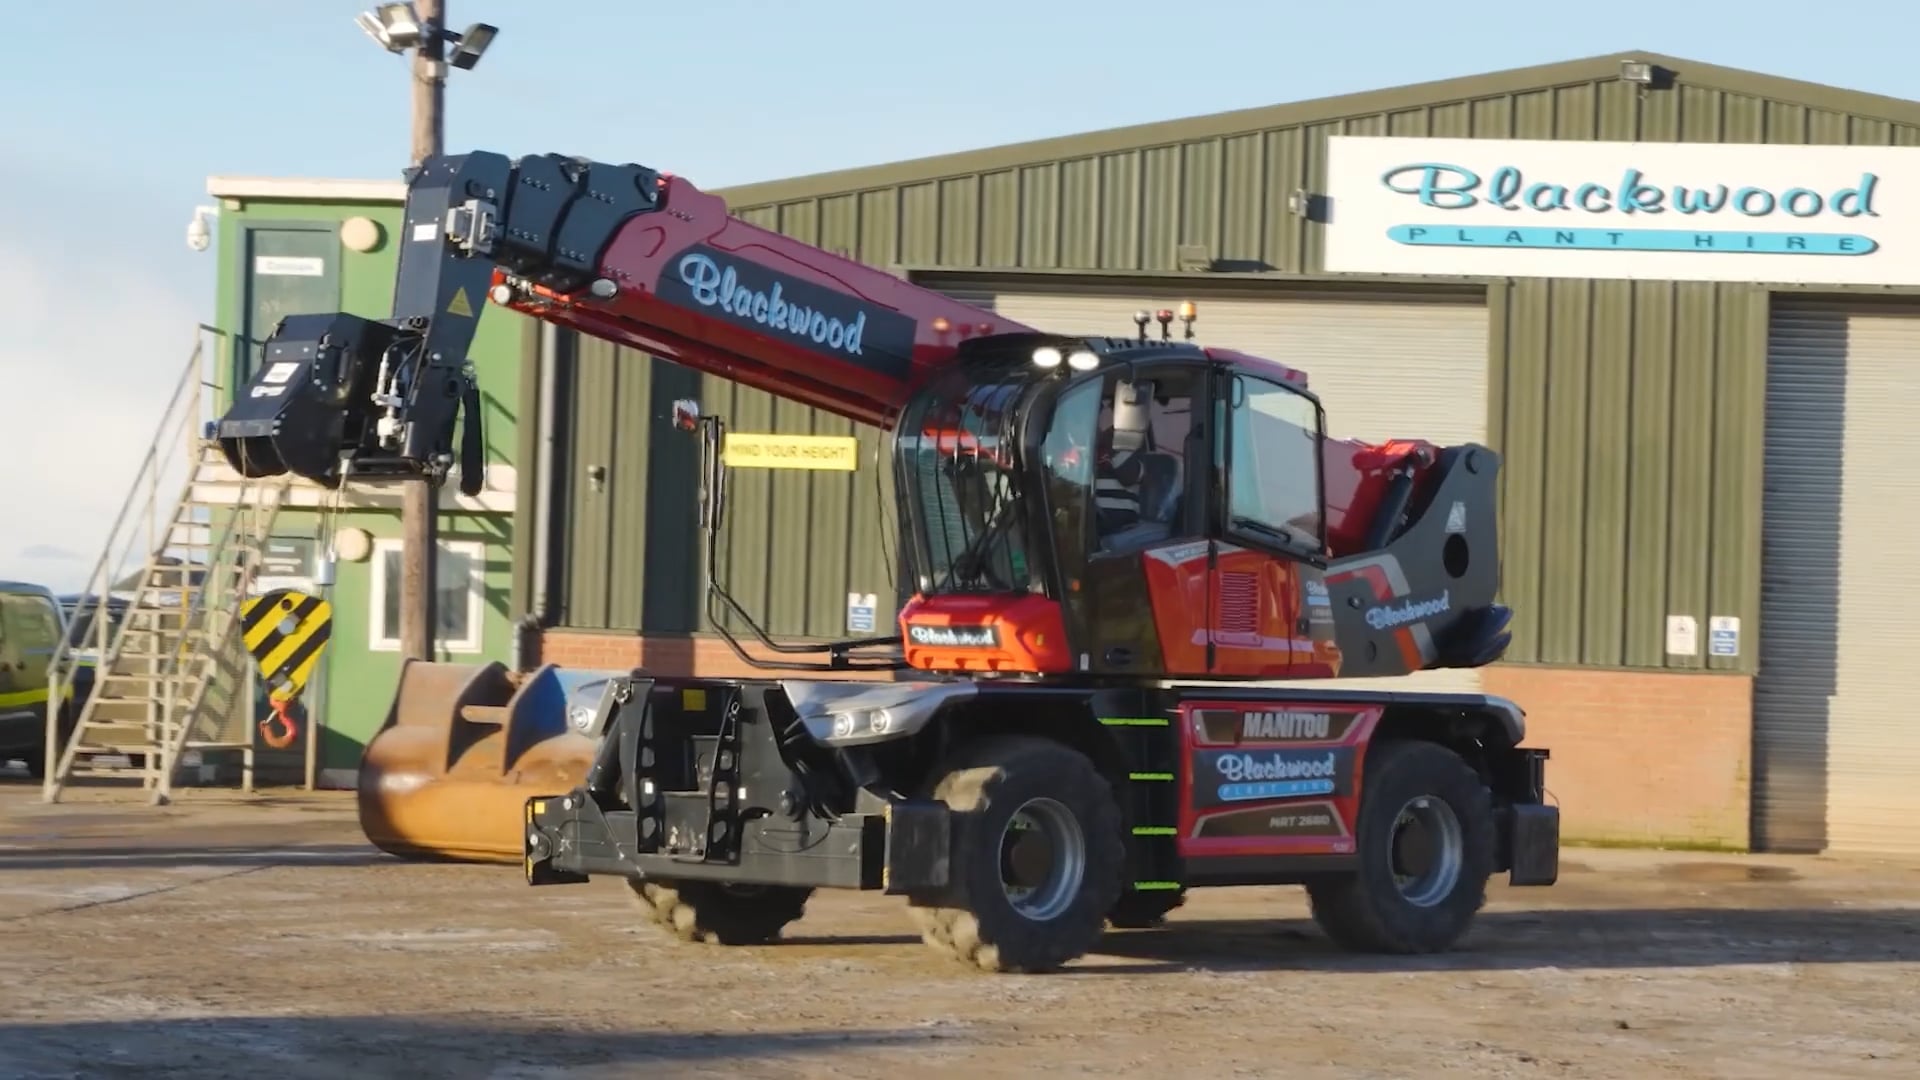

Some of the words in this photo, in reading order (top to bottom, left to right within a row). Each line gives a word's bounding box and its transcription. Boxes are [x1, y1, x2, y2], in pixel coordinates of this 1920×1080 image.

[1381, 162, 1880, 217] Blackwood
[1408, 227, 1624, 246] PLANT
[1694, 234, 1855, 252] HIRE
[678, 253, 866, 355] Blackwood
[764, 445, 797, 458] YOUR
[803, 446, 847, 459] HEIGHT
[1365, 589, 1450, 629] Blackwood
[911, 627, 995, 645] Blackwood
[1243, 711, 1330, 738] MANITOU
[1216, 752, 1336, 781] Blackwood
